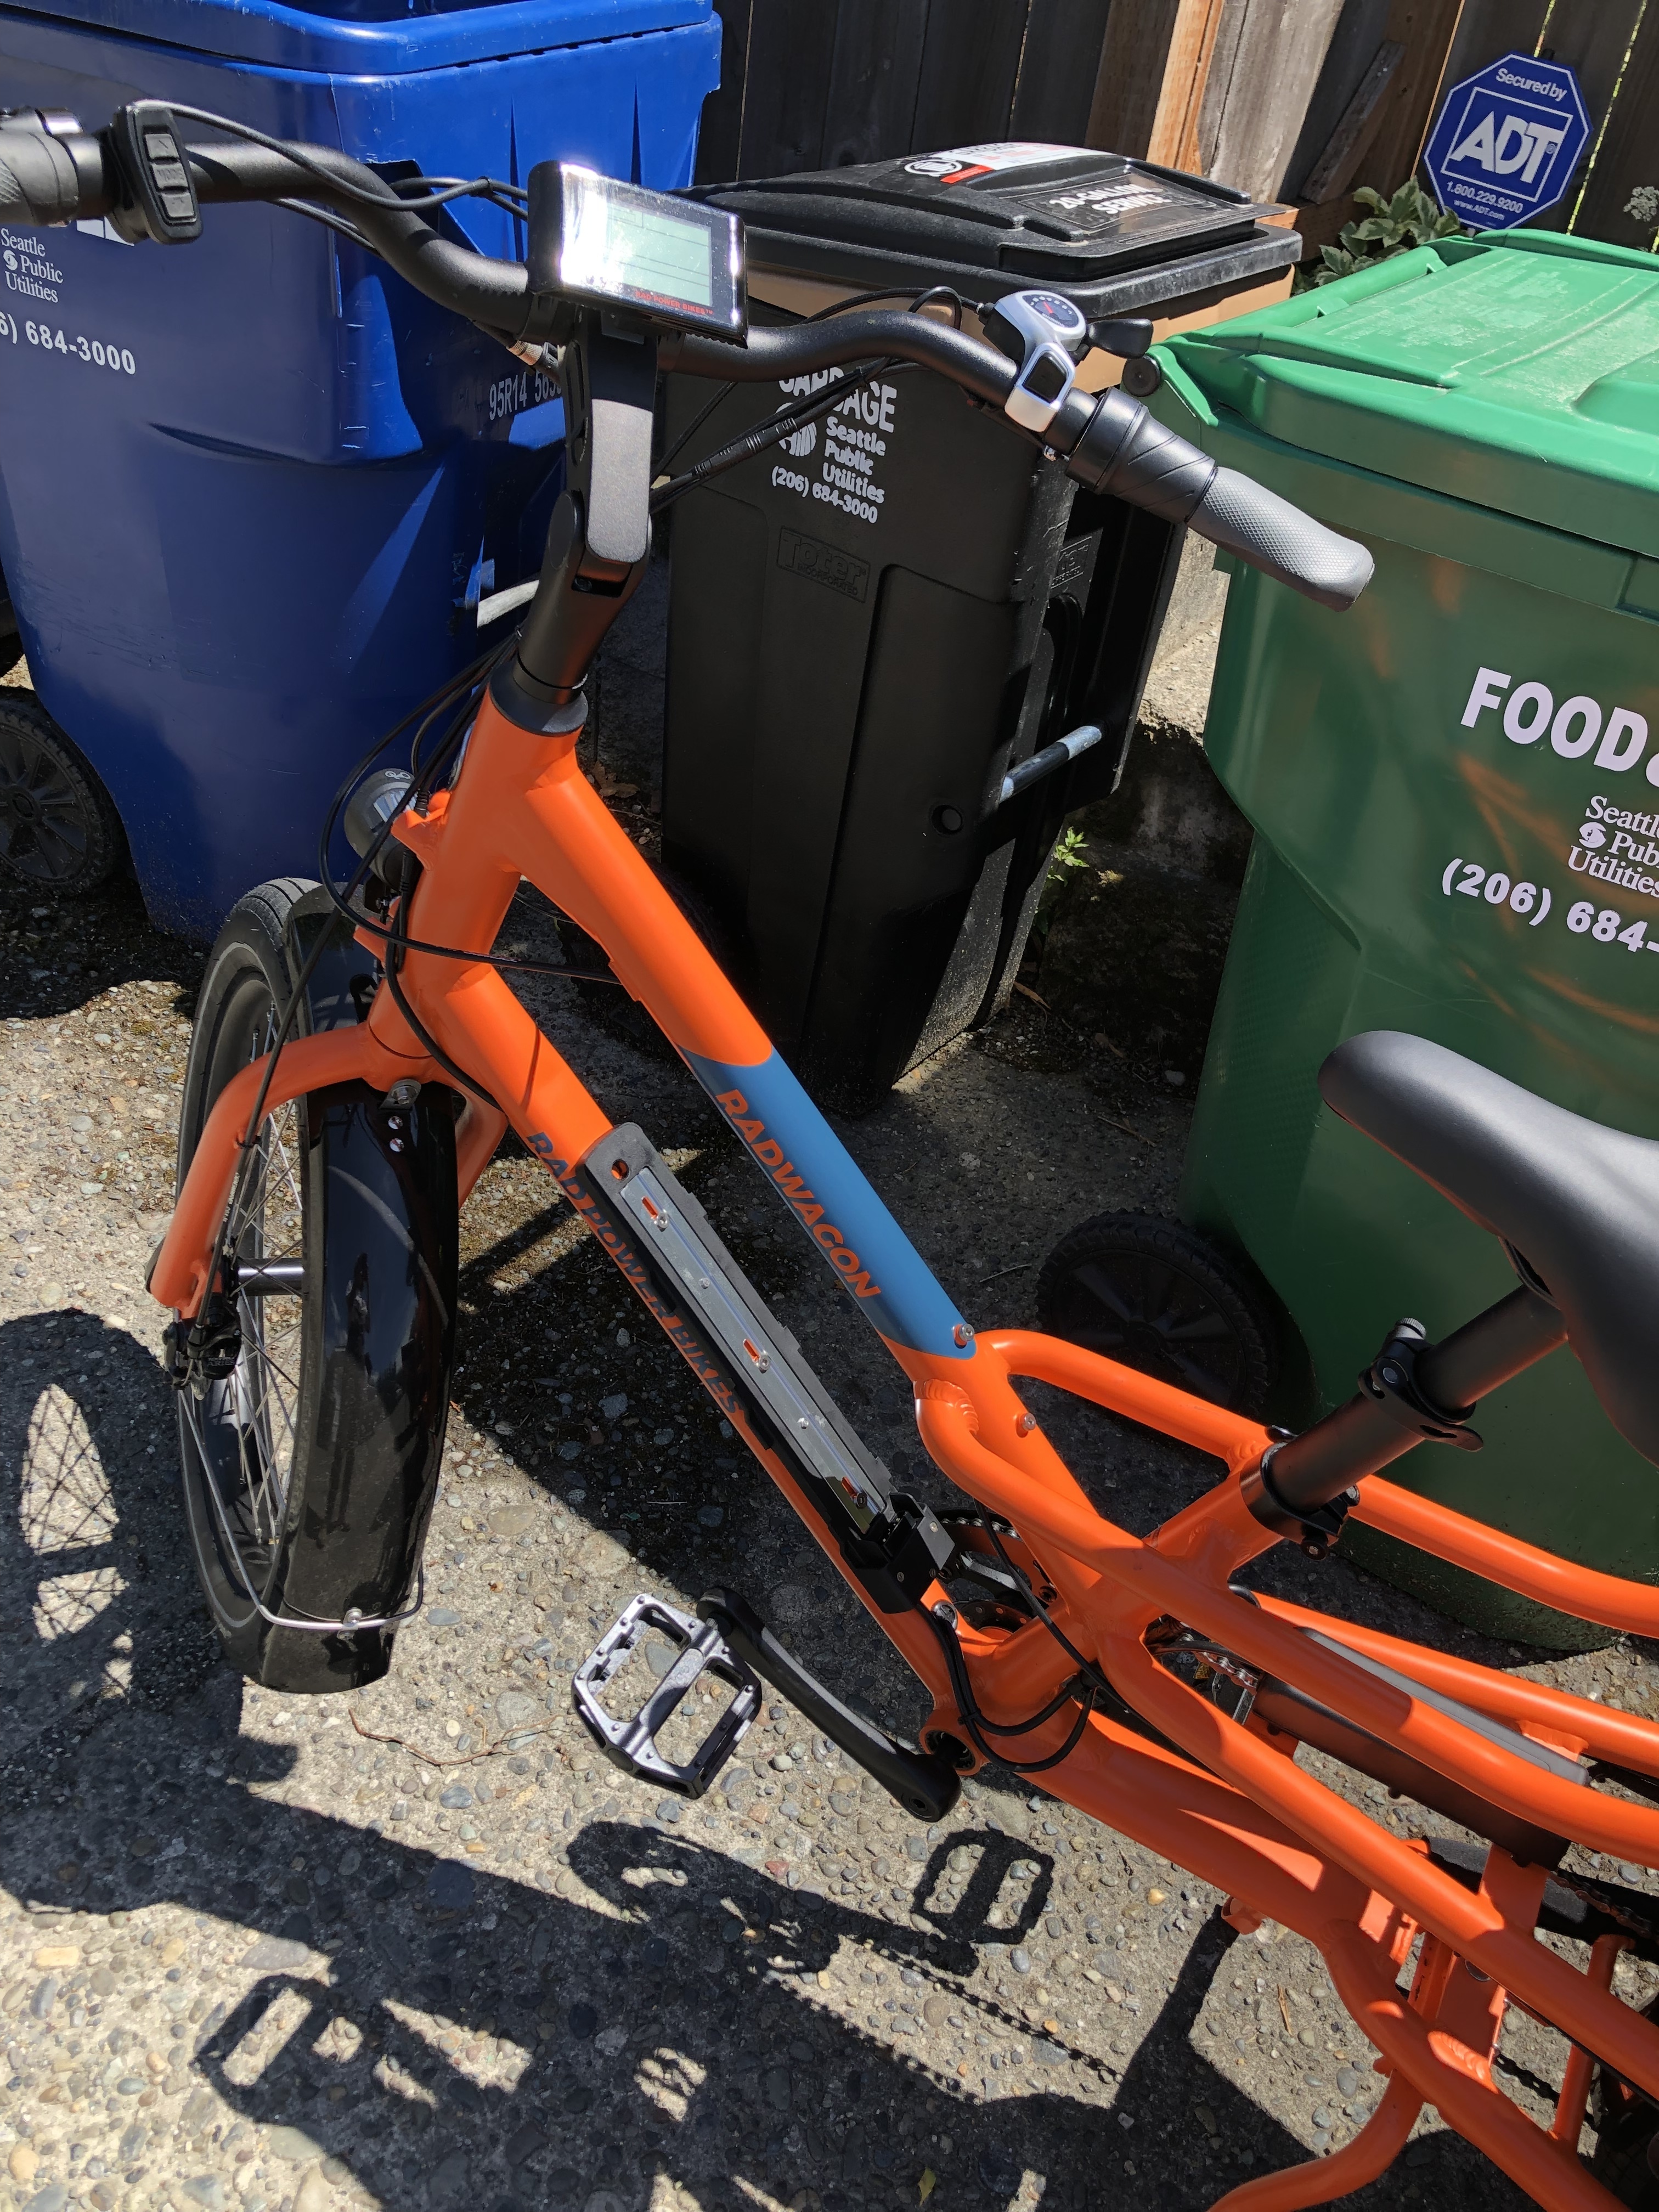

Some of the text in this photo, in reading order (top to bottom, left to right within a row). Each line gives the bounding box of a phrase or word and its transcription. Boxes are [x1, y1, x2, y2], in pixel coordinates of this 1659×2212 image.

[1496, 67, 1567, 102] Secured by
[1091, 194, 1172, 214] SERVICE
[1447, 180, 1523, 213] 1.800.229.9200
[1454, 199, 1505, 221] www.ADT.com
[1, 228, 46, 257] Seattle
[4, 270, 59, 303] Utilities
[20, 254, 64, 284] Public
[635, 290, 652, 300] RAD
[653, 296, 681, 308] POWER
[25, 320, 136, 375] 684-3000
[489, 371, 527, 421] 95R14
[826, 416, 886, 456] Seattle
[824, 439, 874, 476] Public
[771, 465, 878, 524] (206) 684-3000
[822, 462, 885, 504] Utilities
[1460, 666, 1649, 772] FOOD
[1585, 795, 1659, 839] Seattl
[1442, 857, 1552, 927] (206)
[715, 1088, 881, 1299] RADWAGON
[526, 1132, 589, 1200] RAD
[669, 1324, 741, 1414] BIKES
